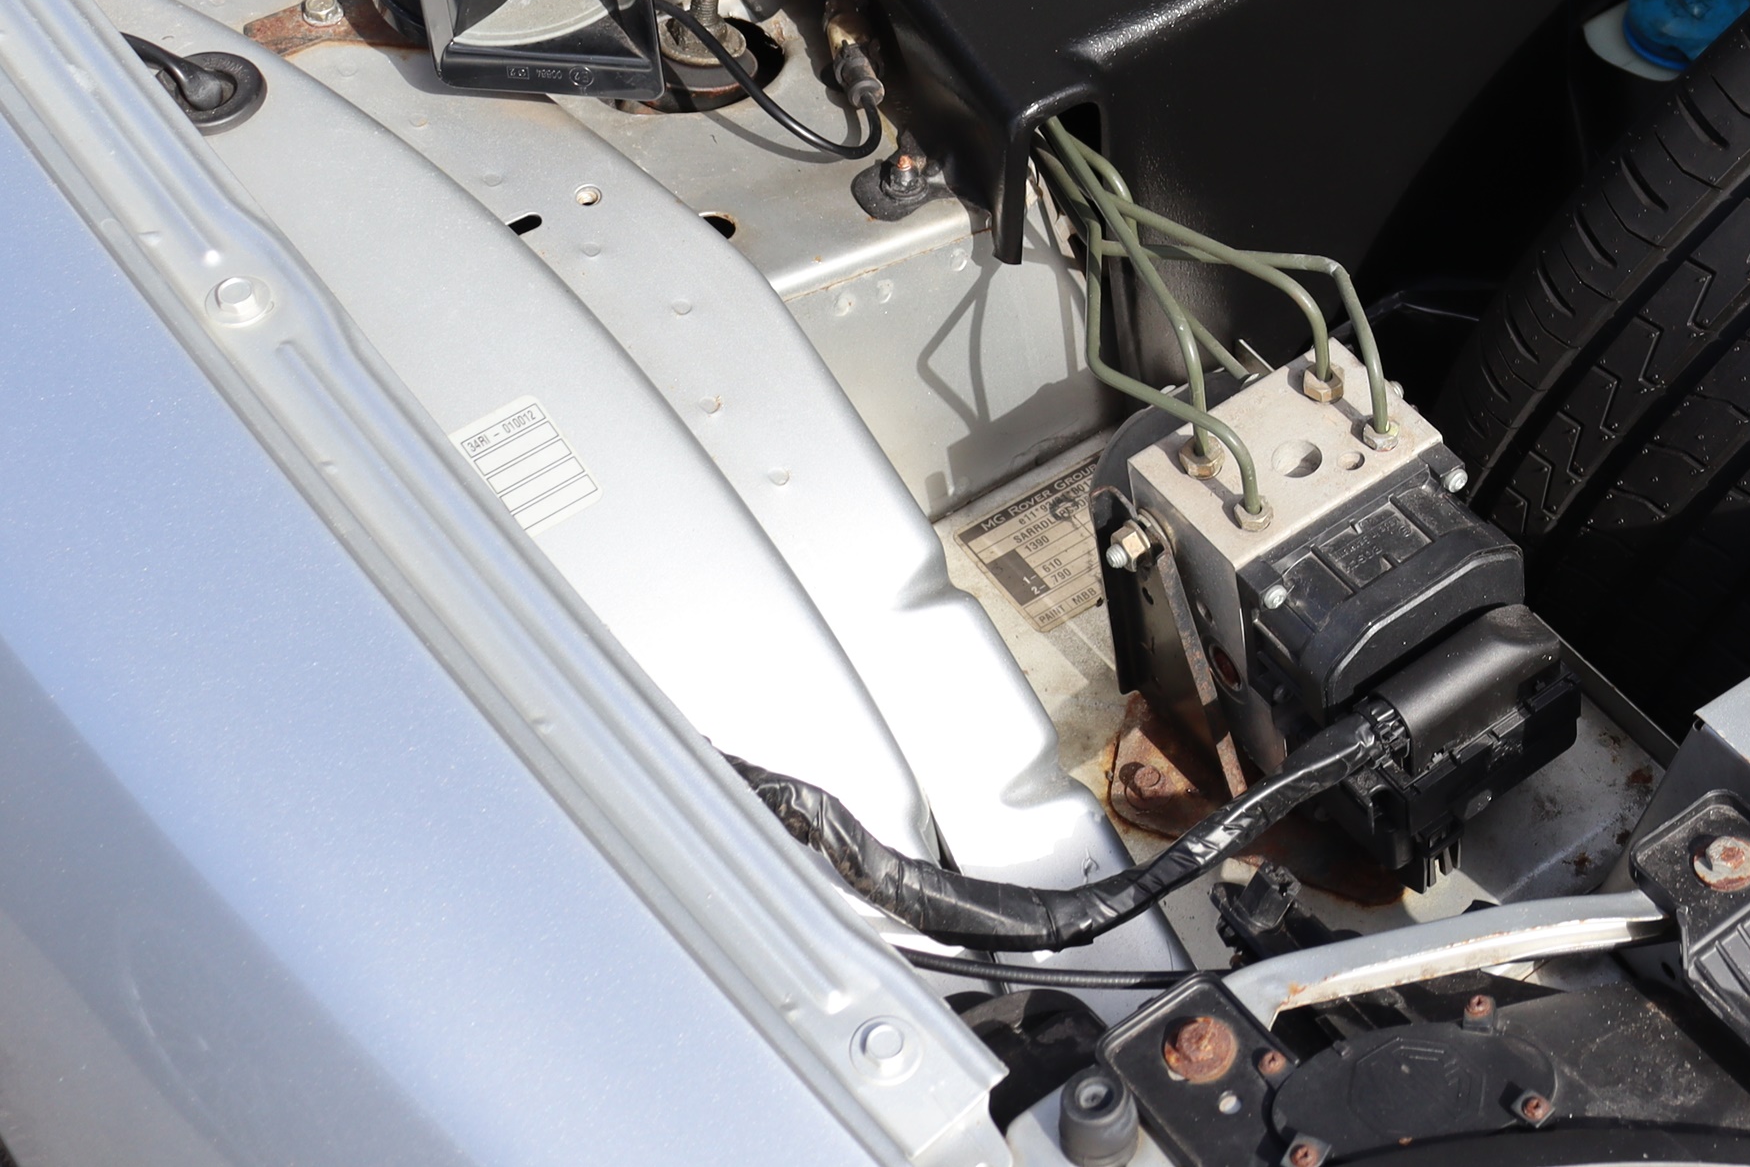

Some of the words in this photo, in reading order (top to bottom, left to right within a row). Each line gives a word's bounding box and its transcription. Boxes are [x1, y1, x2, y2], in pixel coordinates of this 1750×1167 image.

[502, 409, 536, 434] 010012
[980, 512, 1005, 532] MG
[1007, 489, 1053, 516] ROVER
[1024, 534, 1050, 553] 1390
[1042, 557, 1062, 573] 610
[1050, 567, 1072, 584] 790
[1038, 604, 1066, 623] PAINT
